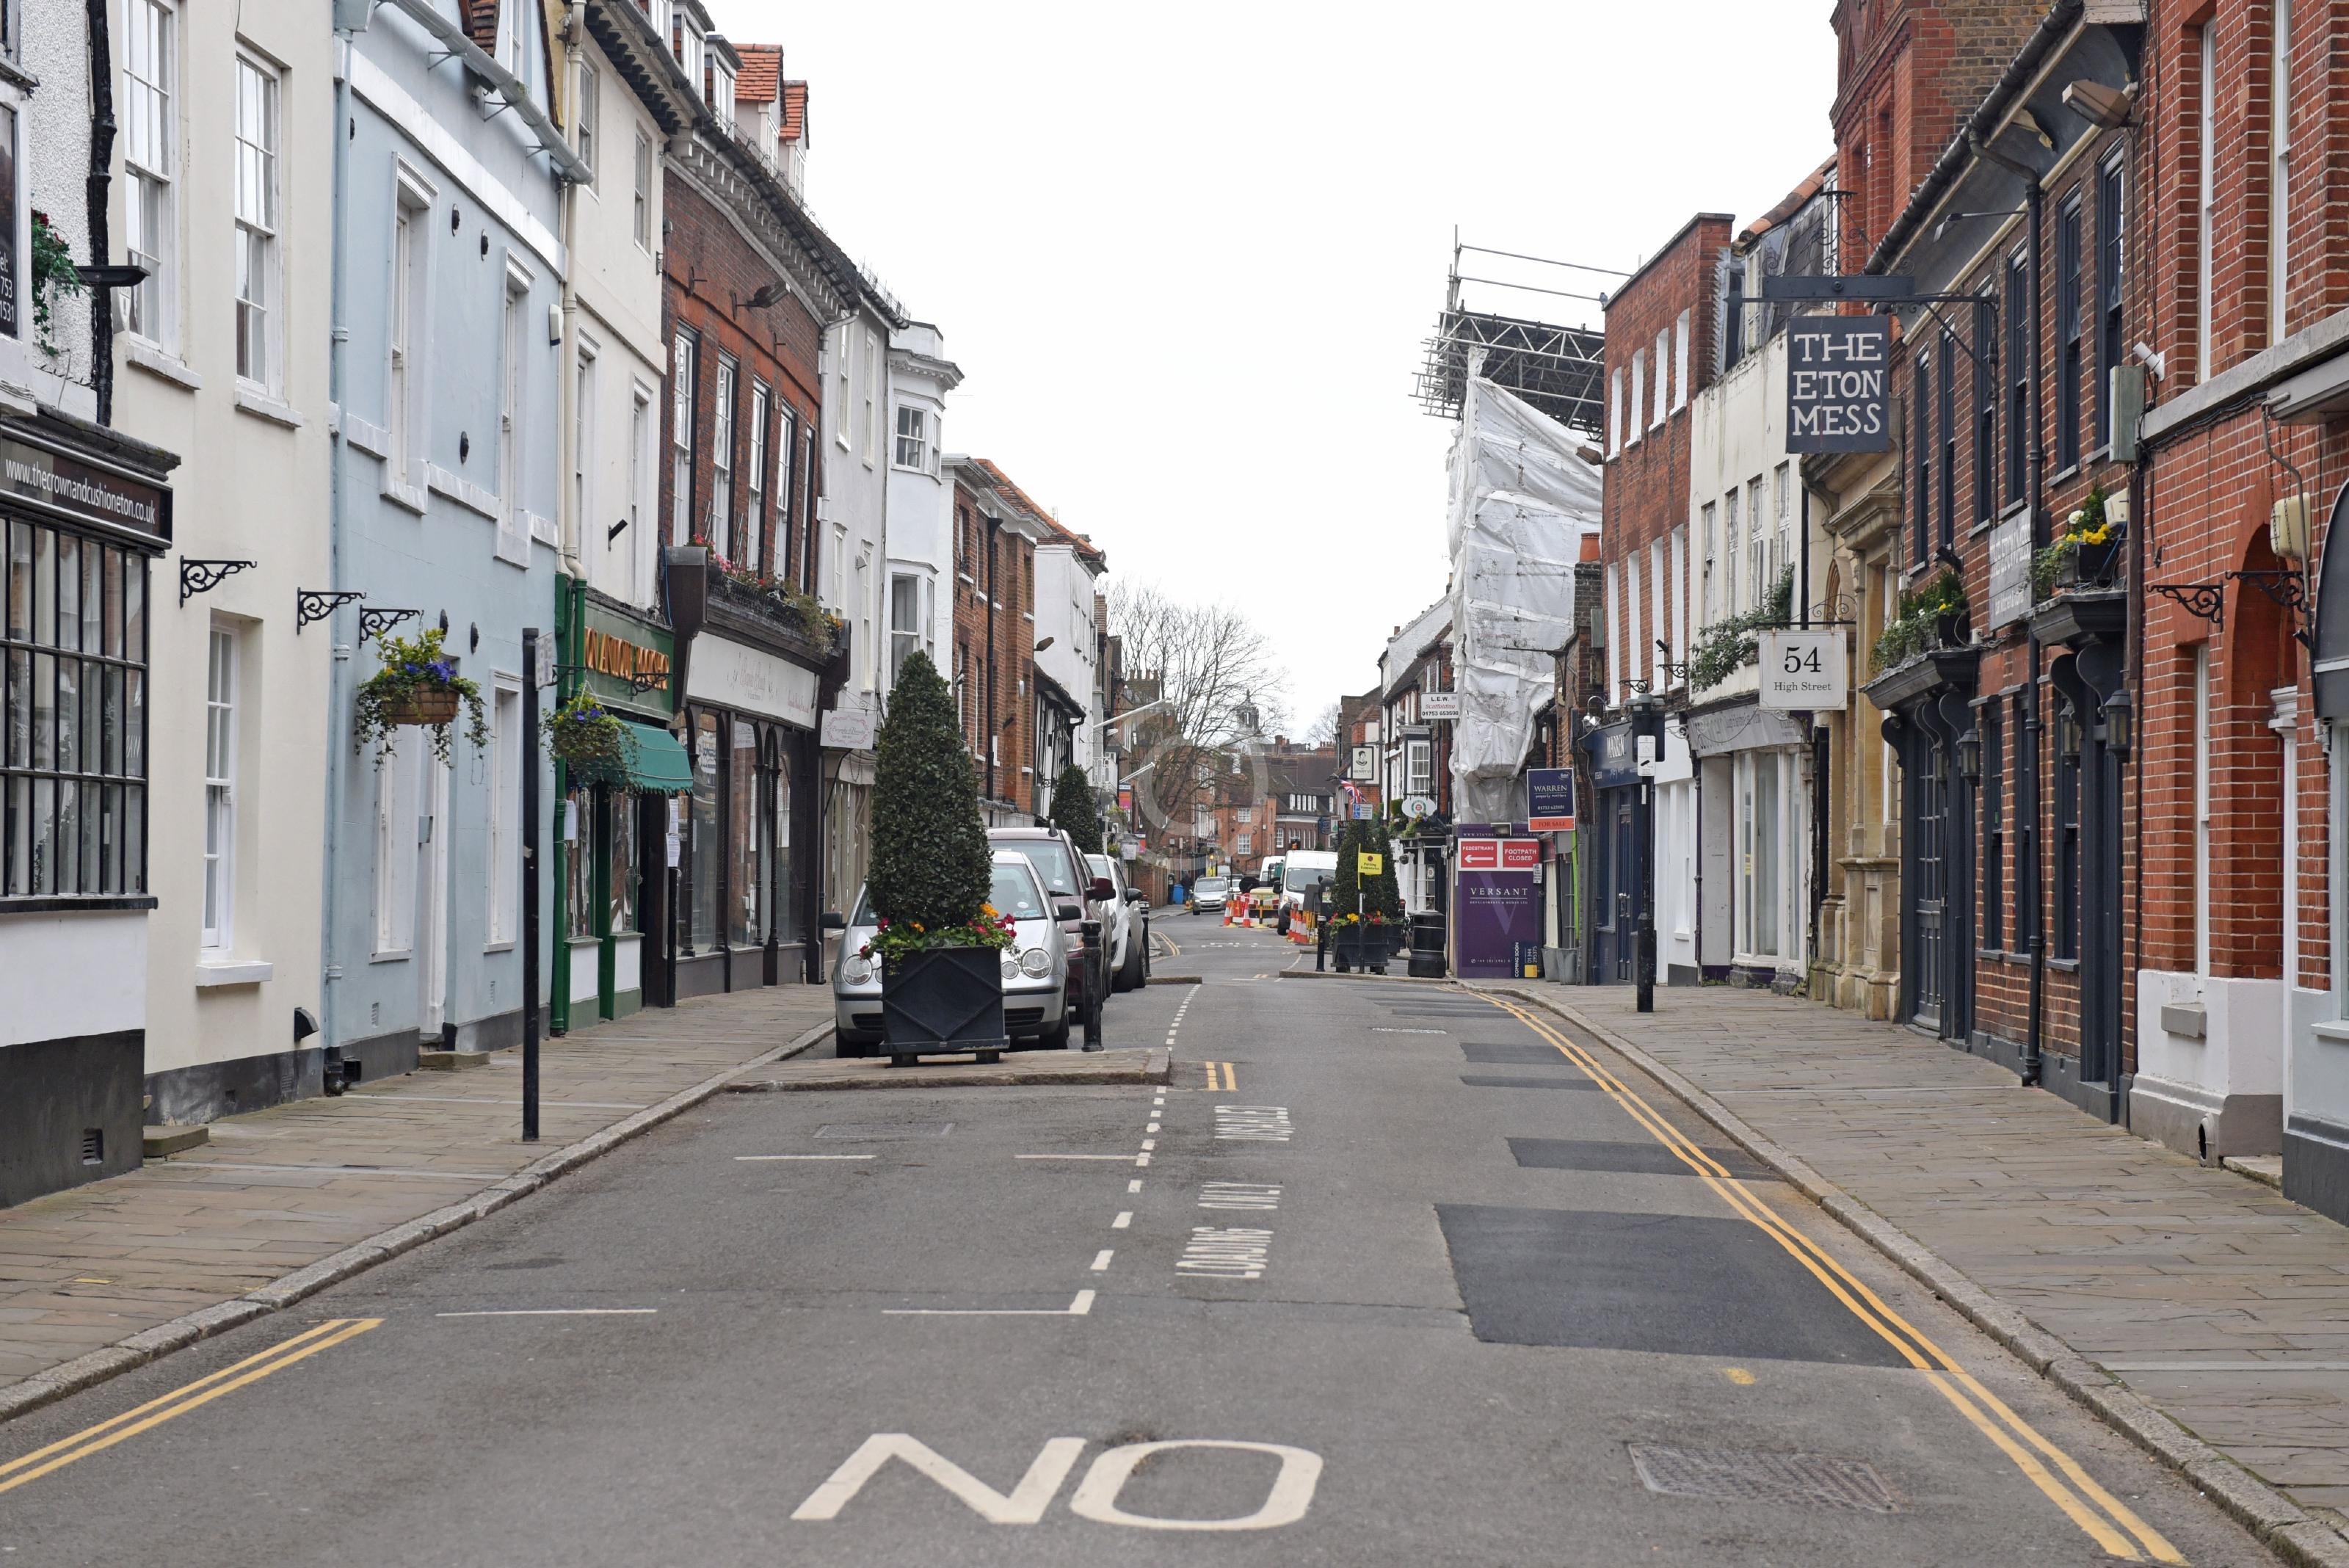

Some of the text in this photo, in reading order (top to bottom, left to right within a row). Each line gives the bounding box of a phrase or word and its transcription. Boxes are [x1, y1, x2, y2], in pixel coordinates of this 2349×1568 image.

[0, 252, 8, 273] el:
[1793, 333, 1883, 362] THE
[1792, 369, 1884, 400] ETON
[1791, 403, 1882, 436] MESS
[5, 458, 156, 524] www.thecrownandcushioneton.co.uk
[1784, 646, 1822, 673] 54
[1773, 681, 1831, 693] High Street
[1534, 784, 1567, 792] WARREN
[1470, 888, 1528, 896] VERSANT
[1214, 1105, 1296, 1141] DISABLED
[1175, 1181, 1285, 1278] LOADING ONLY
[789, 1432, 1324, 1531] NO
